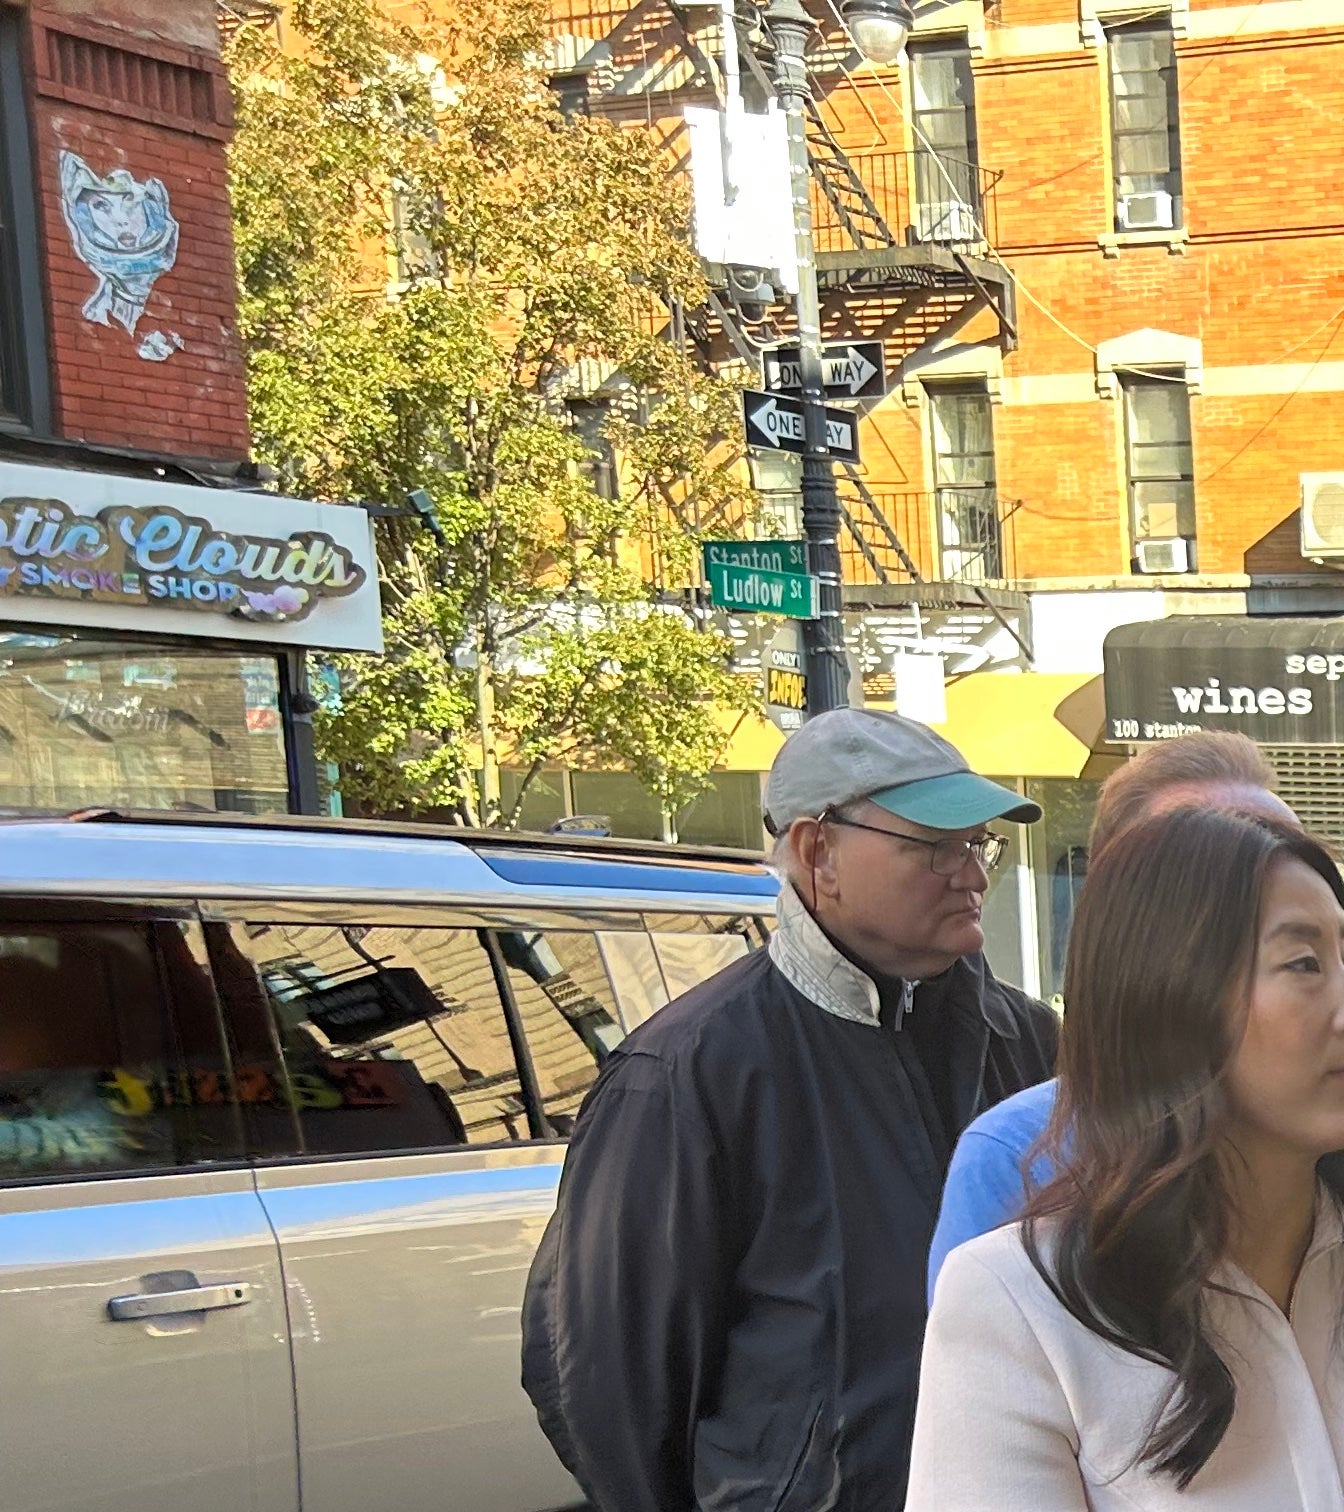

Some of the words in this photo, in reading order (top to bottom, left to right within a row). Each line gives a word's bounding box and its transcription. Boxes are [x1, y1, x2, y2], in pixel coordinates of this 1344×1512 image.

[780, 364, 802, 386] ON
[830, 361, 865, 383] WAY
[766, 411, 802, 438] ONE
[0, 507, 109, 562] tic
[119, 514, 357, 587] Clouds
[709, 545, 783, 573] Stanton
[789, 545, 803, 565] St
[20, 562, 141, 594] SMOKE
[150, 574, 239, 601] SHOP
[722, 569, 784, 608] Ludlow
[790, 581, 803, 600] St
[1171, 677, 1313, 715] wines
[1112, 719, 1139, 738] 100
